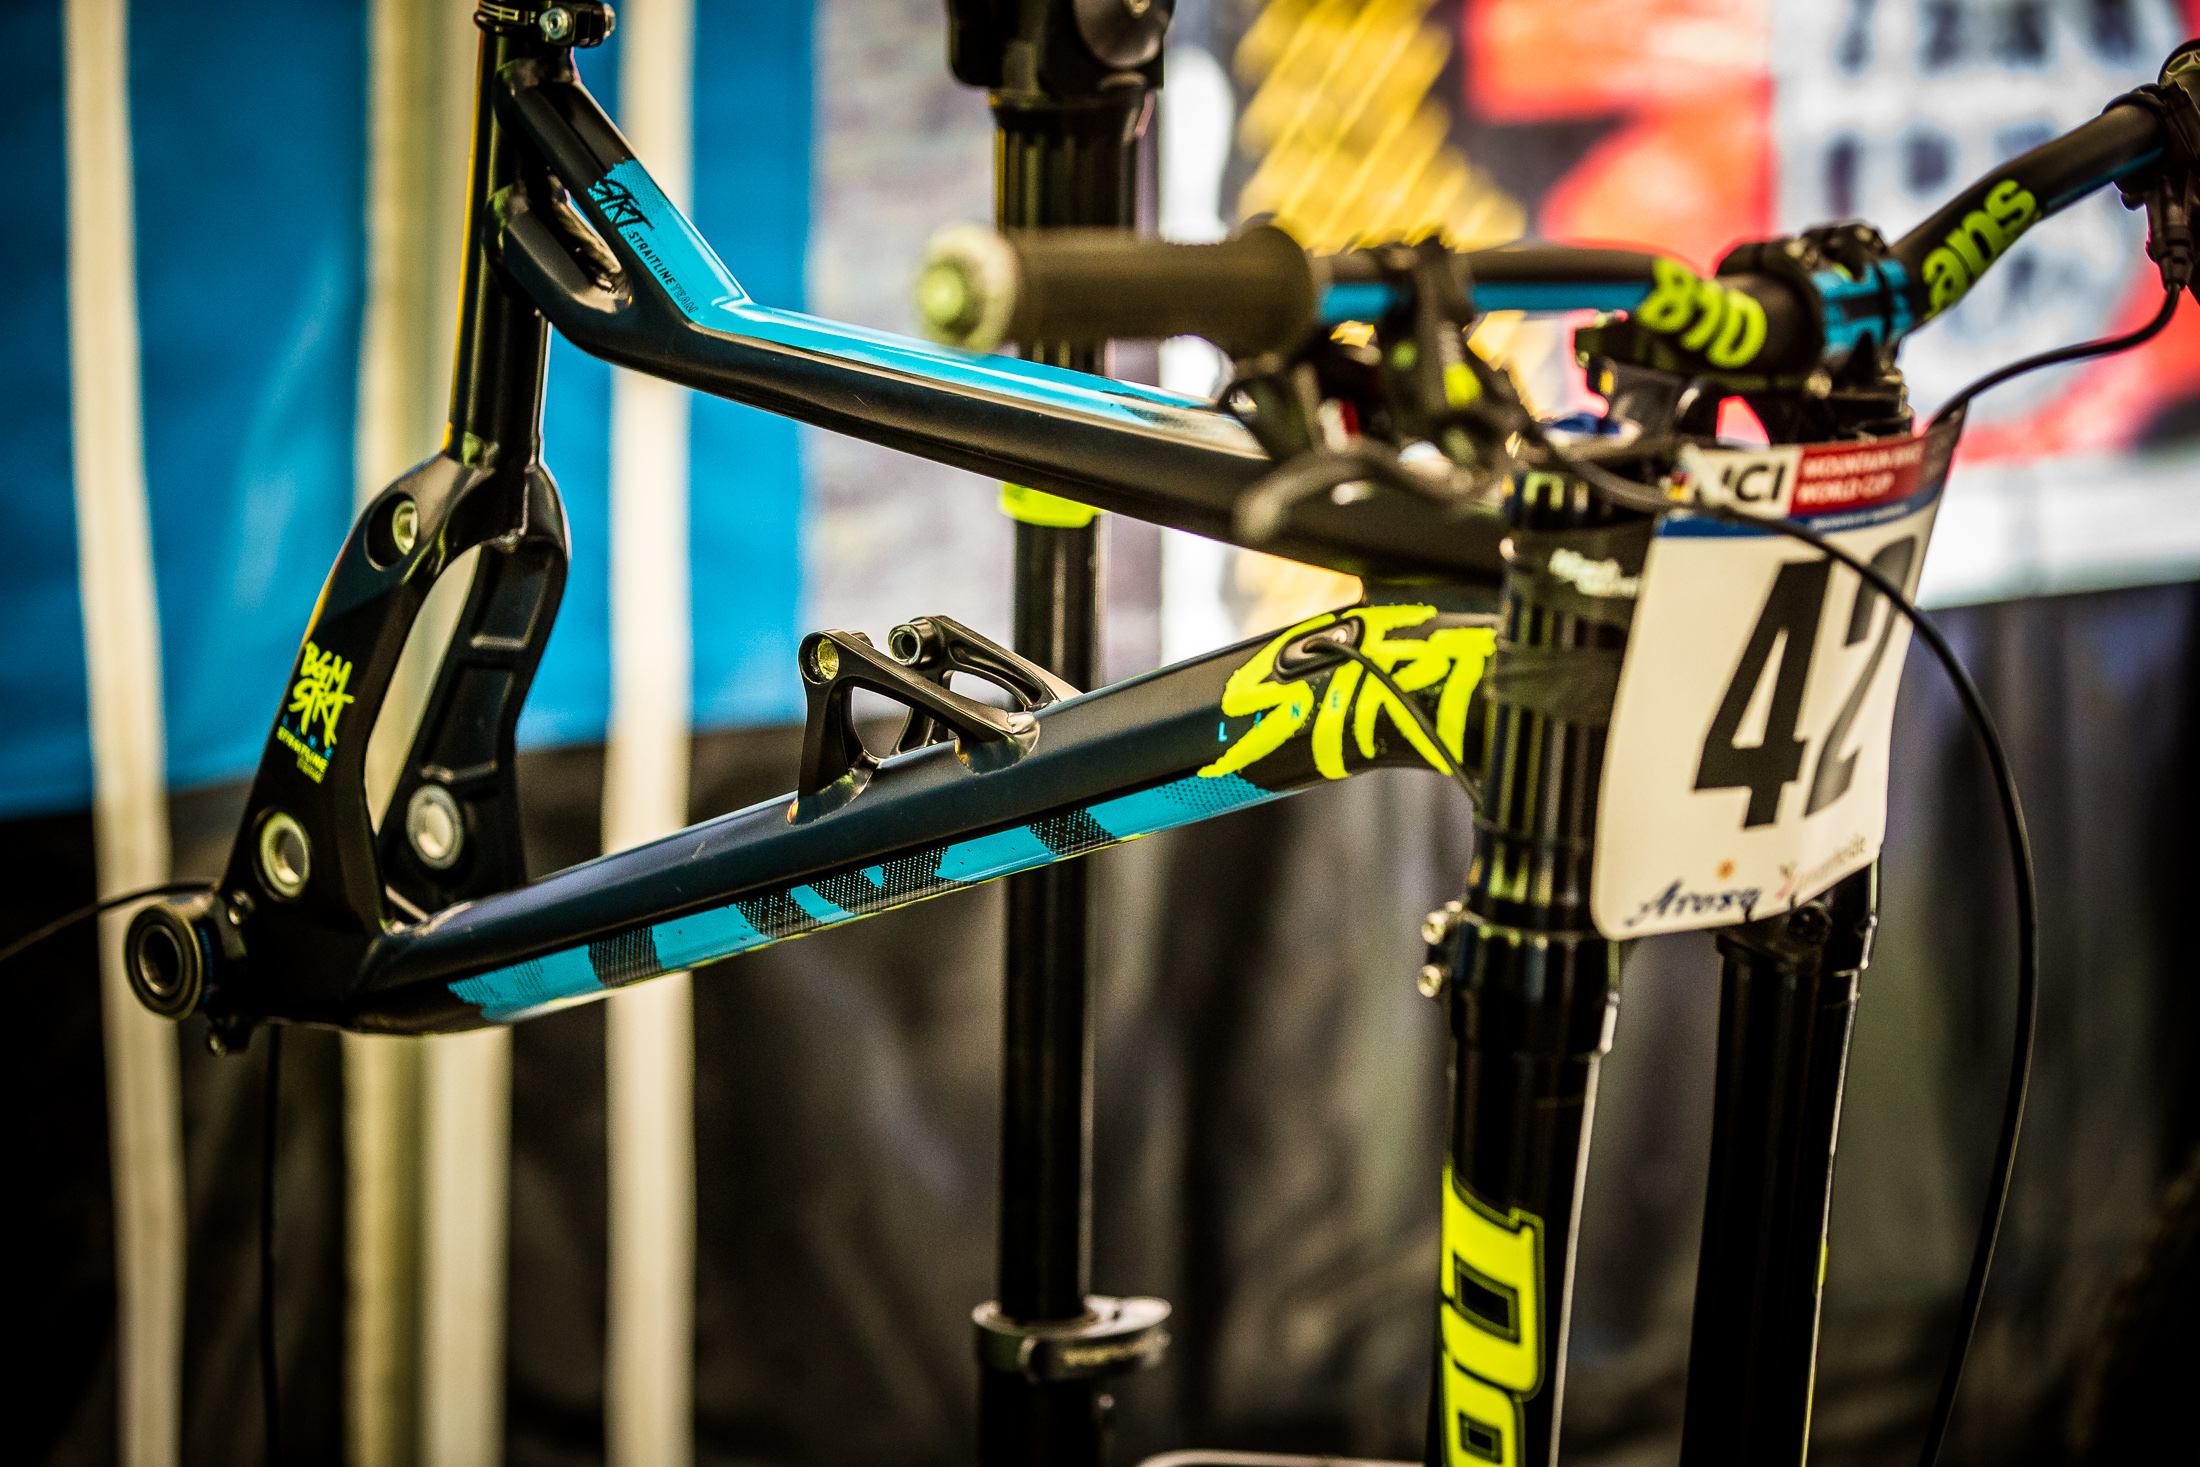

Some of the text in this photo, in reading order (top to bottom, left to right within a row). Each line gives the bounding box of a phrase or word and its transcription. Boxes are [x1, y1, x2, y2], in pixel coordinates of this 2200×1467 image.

[628, 231, 699, 314] STRAITLINE TEAM
[1693, 533, 1915, 829] 42
